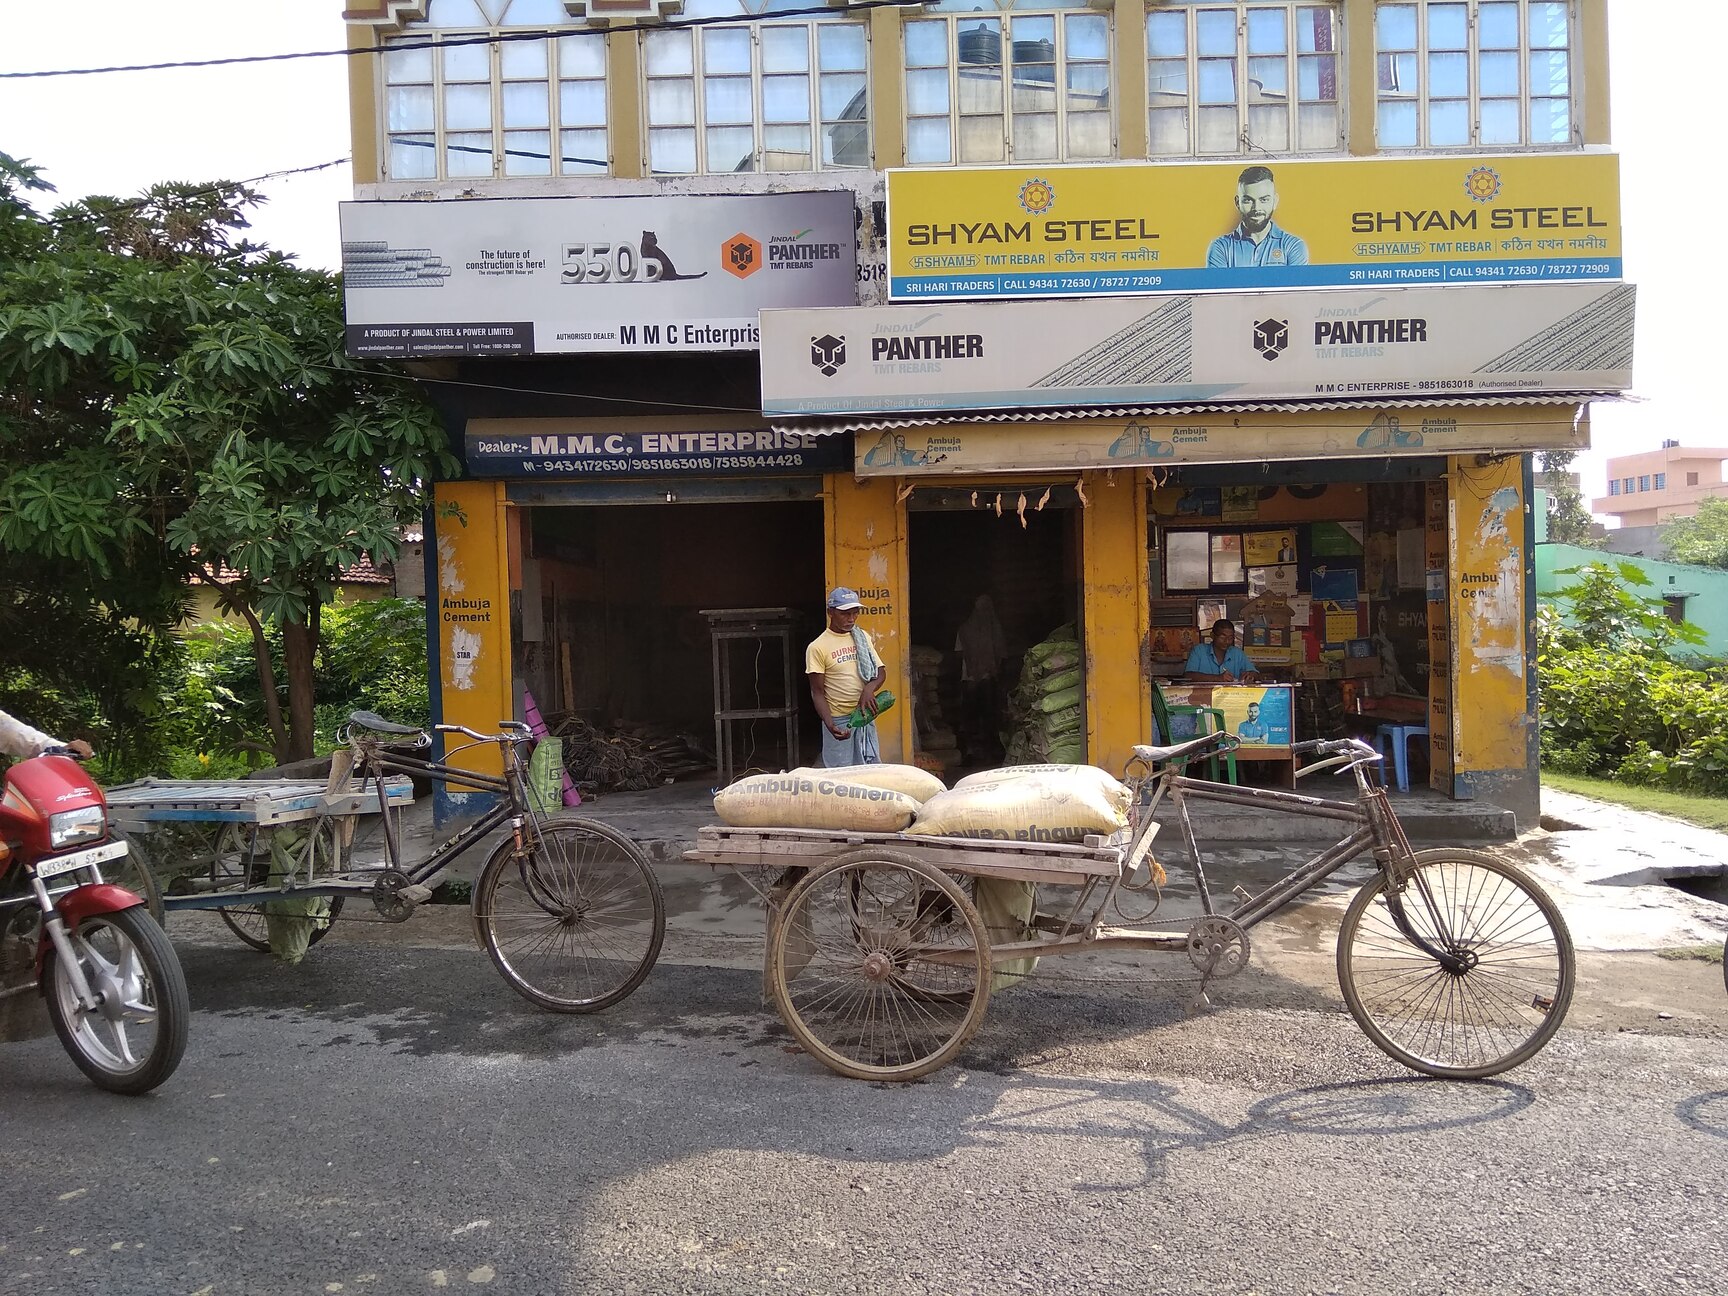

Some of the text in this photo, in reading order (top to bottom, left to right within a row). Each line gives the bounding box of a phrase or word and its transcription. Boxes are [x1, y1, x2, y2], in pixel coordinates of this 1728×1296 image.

[1352, 206, 1607, 232] SHYAM STEEL
[907, 218, 1160, 246] SHYAM STEEL
[1369, 241, 1491, 254] SHYAM TMT REBAR
[1500, 237, 1532, 250] কঠিন
[1537, 238, 1563, 250] যখন
[480, 250, 530, 259] The future of
[769, 243, 840, 261] PANTHER
[1054, 250, 1085, 264] কঠিন
[1090, 251, 1116, 262] যখন
[466, 259, 546, 270] construction is here!
[925, 254, 1045, 268] SHYAM TMT REBAR
[1350, 268, 1440, 279] SRI HARI TRADERS
[1450, 266, 1473, 276] CALL
[1475, 266, 1504, 276] 94341
[1507, 265, 1537, 275] 72630
[1548, 264, 1577, 274] 78727
[1580, 264, 1610, 274] 72909
[906, 280, 994, 293] SRI HARI TRADERS
[1004, 279, 1027, 289] CALL
[1029, 278, 1058, 289] 94341
[1060, 277, 1090, 288] 72630
[1100, 276, 1130, 287] 78727
[1132, 276, 1161, 286] 72909
[1315, 306, 1359, 318] JINDAL
[370, 330, 400, 338] PRODUCT
[872, 322, 915, 334] JINDAL
[1314, 318, 1427, 345] PANTHER
[620, 324, 759, 348] M M C Enterpris
[872, 334, 984, 361] PANTHER
[1315, 346, 1384, 359] TMT REBARS
[873, 362, 942, 374] TMT REBARS
[1316, 384, 1323, 393] M
[1326, 384, 1334, 392] M
[1337, 384, 1344, 392] C
[1347, 382, 1409, 391] ENTERPRISE
[1418, 380, 1474, 390] 9851863018
[1478, 379, 1543, 388] (Authorised Dealer)
[808, 401, 840, 410] Product
[857, 400, 882, 409] Jindal
[884, 399, 906, 407] Steel
[918, 398, 944, 406] Power
[1421, 418, 1457, 426] Ambuja
[1172, 427, 1207, 436] Ambuja
[1421, 425, 1457, 433] Cement
[531, 435, 633, 455] M.M.C.
[642, 431, 817, 453] ENTERPRISE
[927, 436, 961, 445] Ambuja
[1172, 435, 1208, 443] Cement
[927, 444, 962, 452] Cement
[1461, 572, 1499, 584] Ambu
[853, 587, 890, 600] buja
[443, 598, 490, 610] Ambuja
[858, 604, 892, 615] ment
[444, 612, 490, 621] Cement
[1398, 612, 1427, 627] SHYA
[832, 646, 857, 659] BURNP
[837, 654, 857, 663] CEME
[729, 778, 903, 801] Ambuja Cement
